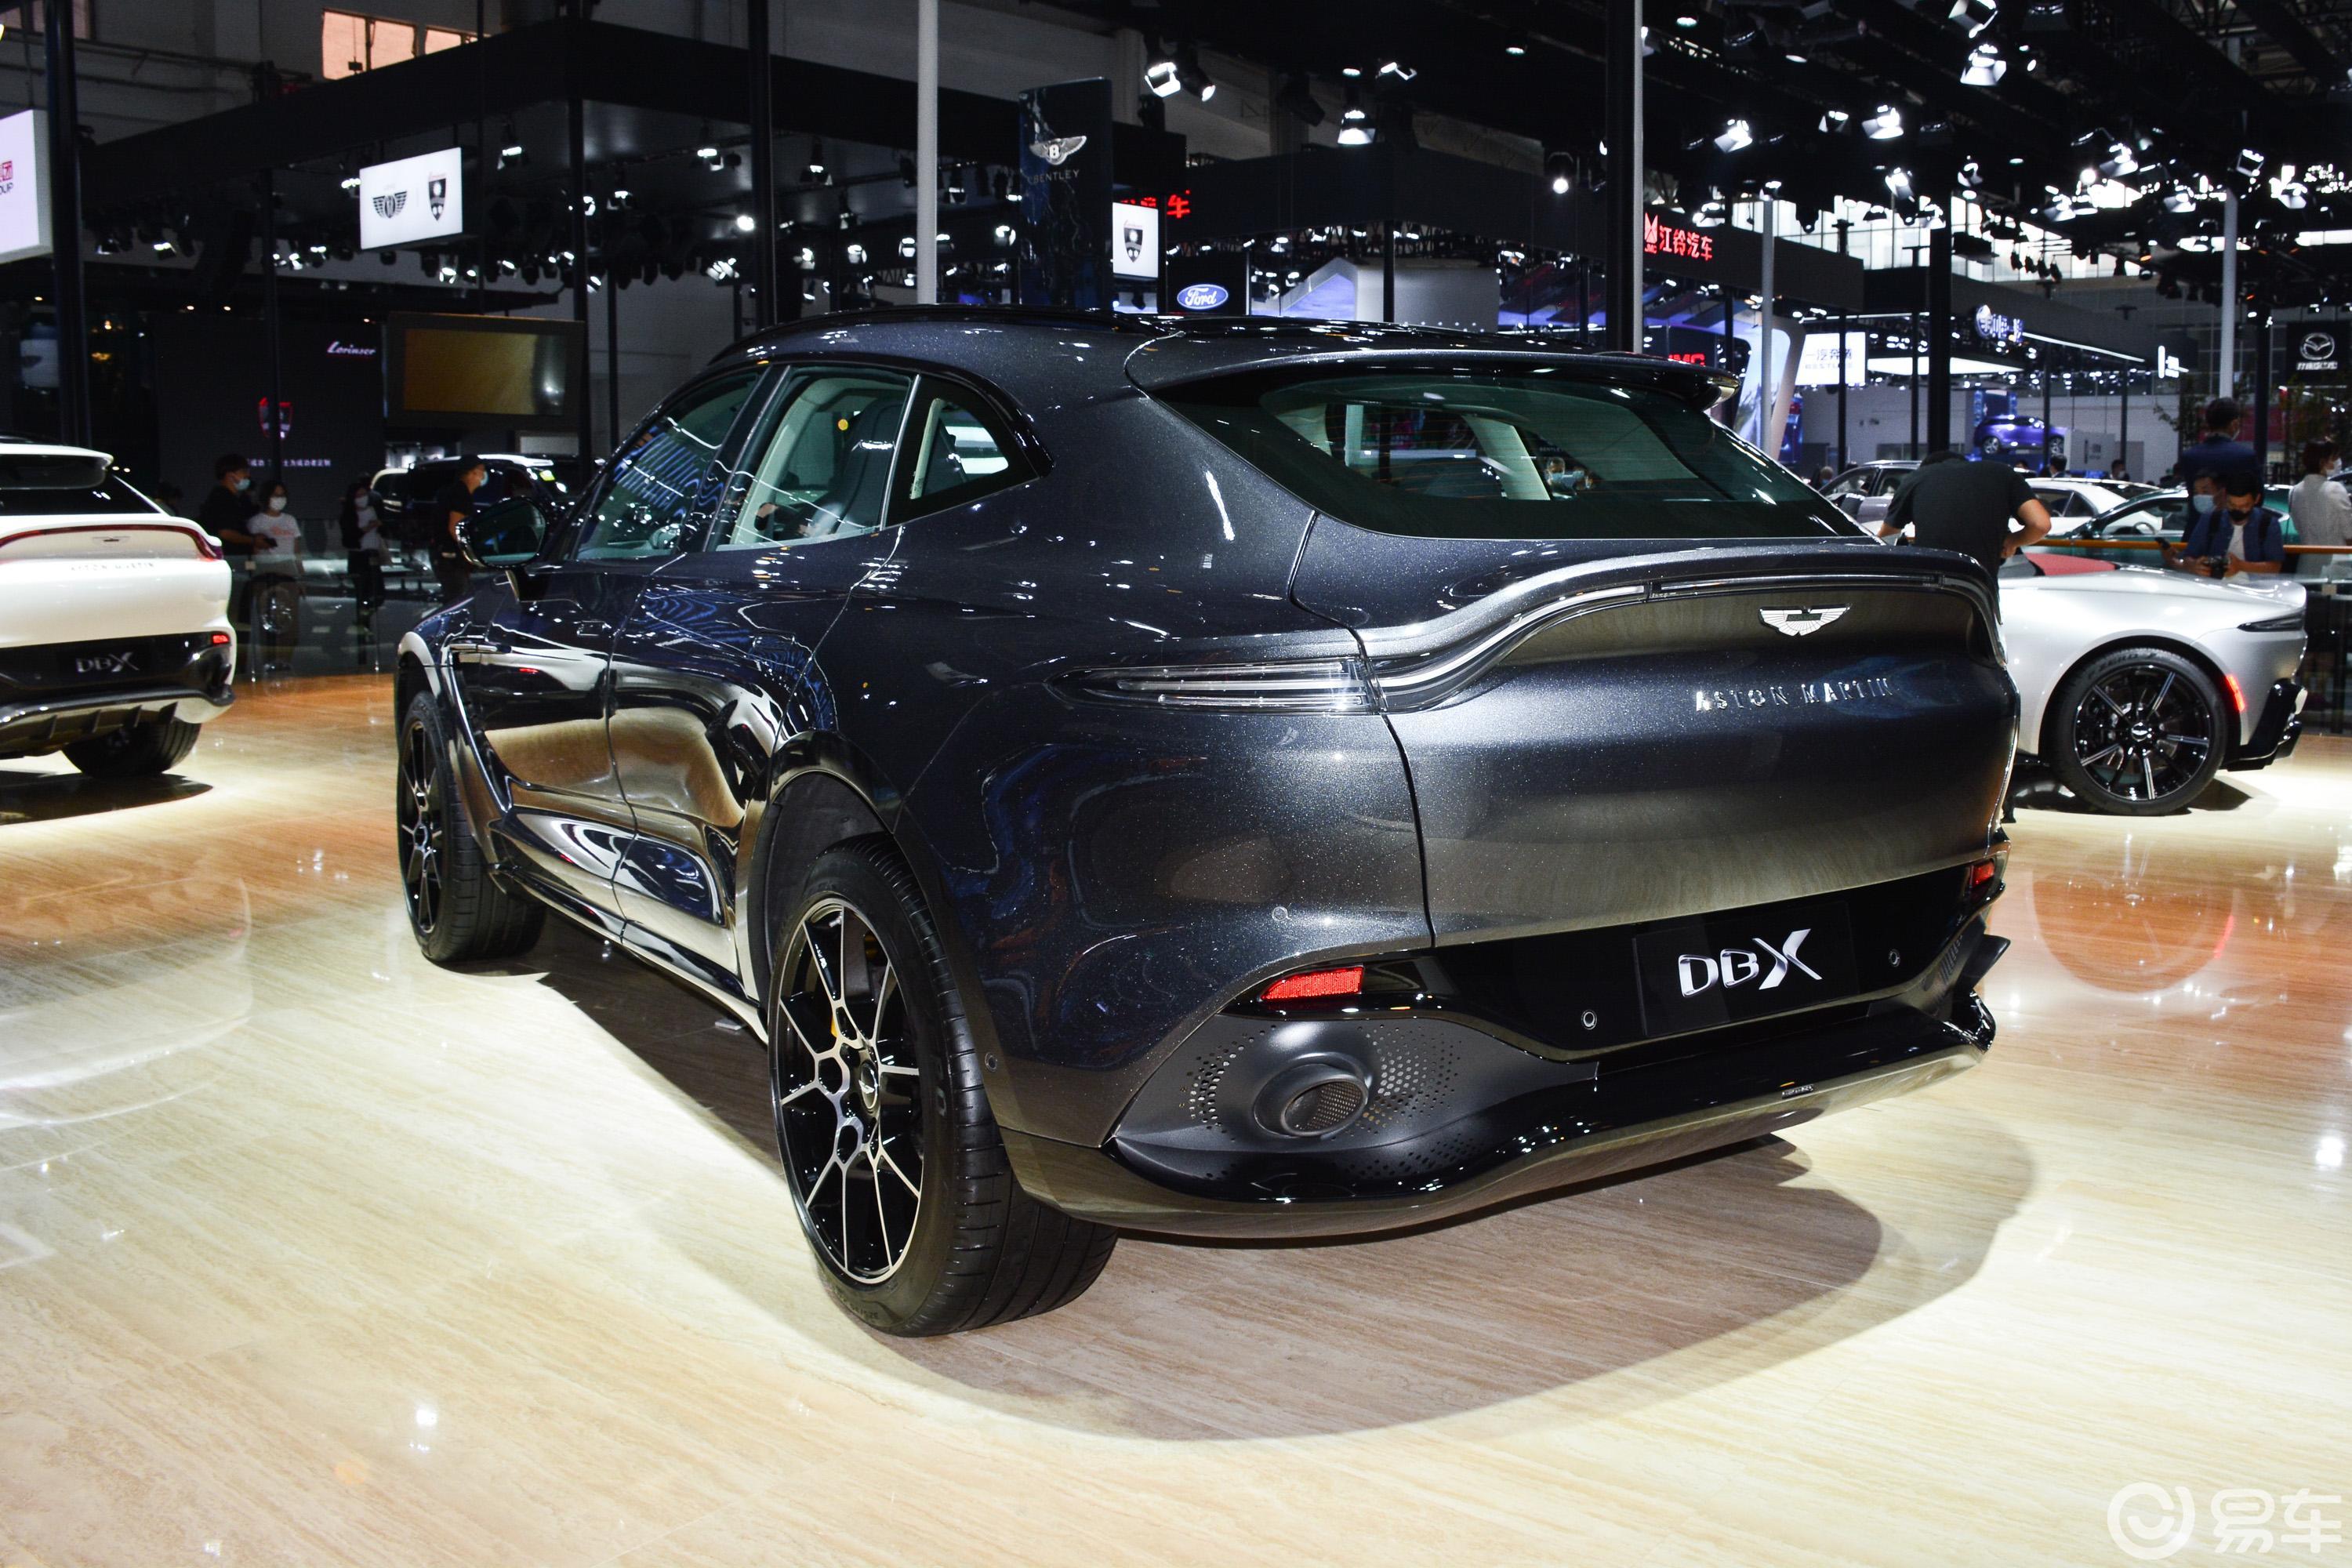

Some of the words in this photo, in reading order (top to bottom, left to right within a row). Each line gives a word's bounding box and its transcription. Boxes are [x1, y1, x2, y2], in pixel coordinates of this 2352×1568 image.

[1033, 169, 1080, 183] BENTLEY
[1659, 225, 1713, 261] 江铃汽车
[1185, 287, 1218, 306] Ford
[327, 341, 376, 355] Lorinser
[76, 652, 140, 673] DBX
[1696, 687, 1788, 712] ASTON
[1801, 677, 1893, 705] MARTIN
[1678, 928, 1823, 997] DBX
